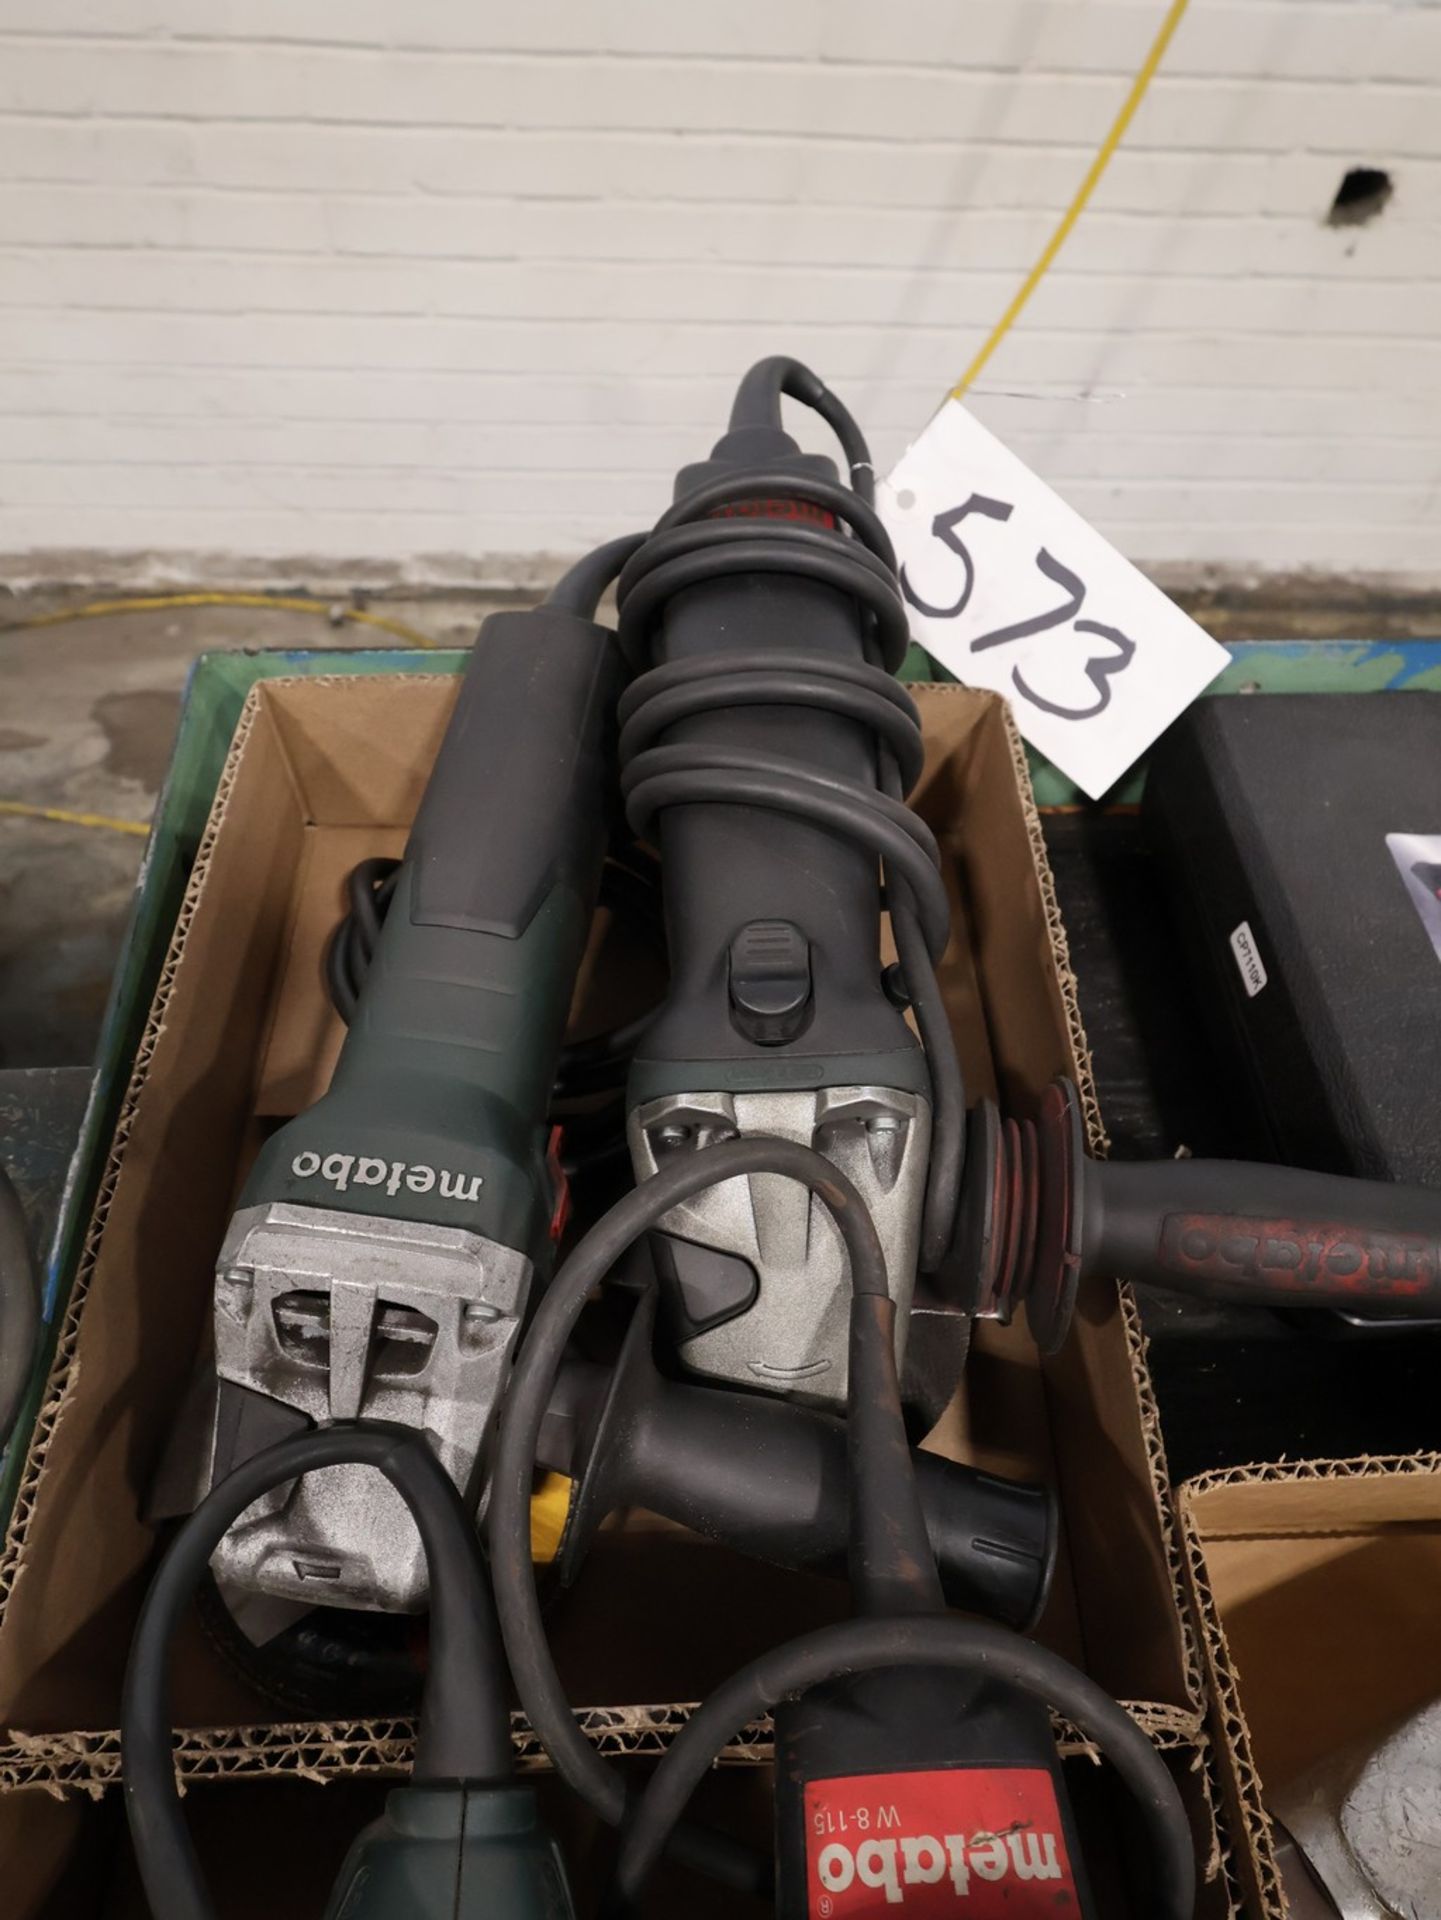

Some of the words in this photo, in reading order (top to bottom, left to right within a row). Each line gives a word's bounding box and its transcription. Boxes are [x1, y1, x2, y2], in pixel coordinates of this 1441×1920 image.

[900, 493, 1136, 721] 573
[292, 1151, 483, 1201] metabo
[1181, 1228, 1424, 1283] metabo
[814, 1807, 870, 1836] 8-115
[876, 1805, 901, 1829] W
[818, 1831, 1063, 1903] metabo
